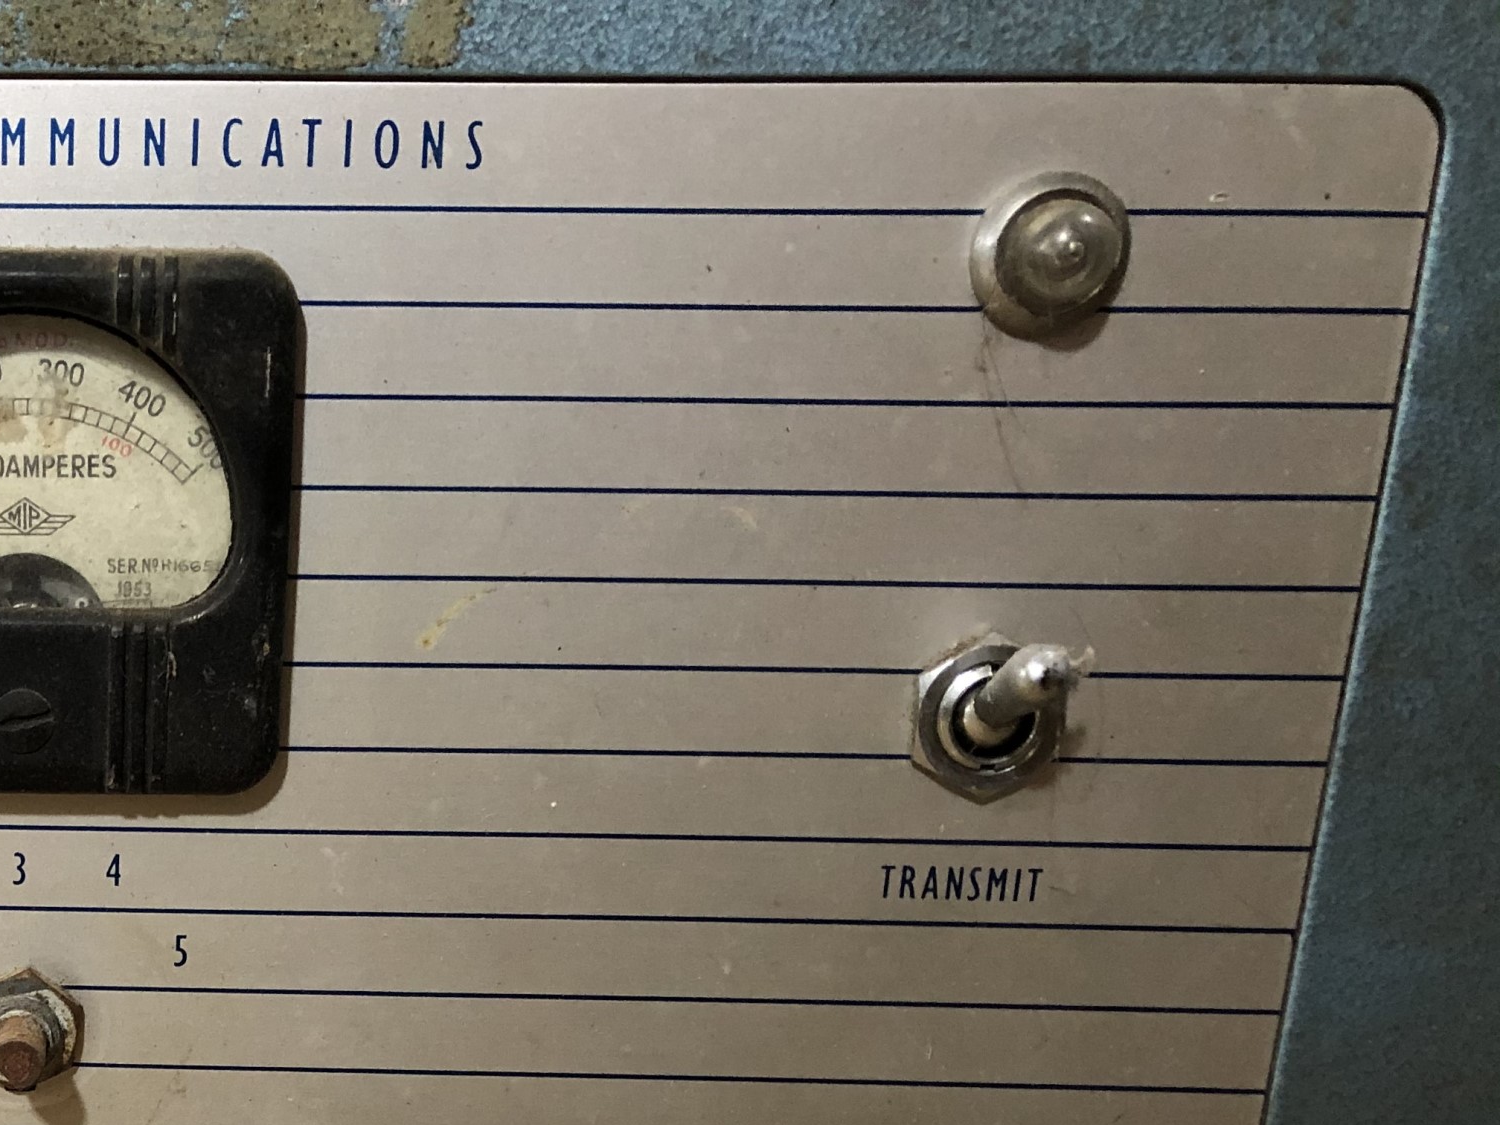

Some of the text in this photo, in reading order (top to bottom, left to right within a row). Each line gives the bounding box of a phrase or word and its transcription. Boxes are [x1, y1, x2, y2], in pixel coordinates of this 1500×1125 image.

[118, 380, 167, 418] 400
[101, 435, 133, 458] 100
[12, 852, 27, 886] 3
[106, 854, 122, 887] 4
[881, 865, 1044, 902] TRANSMIT
[173, 934, 189, 967] 5
